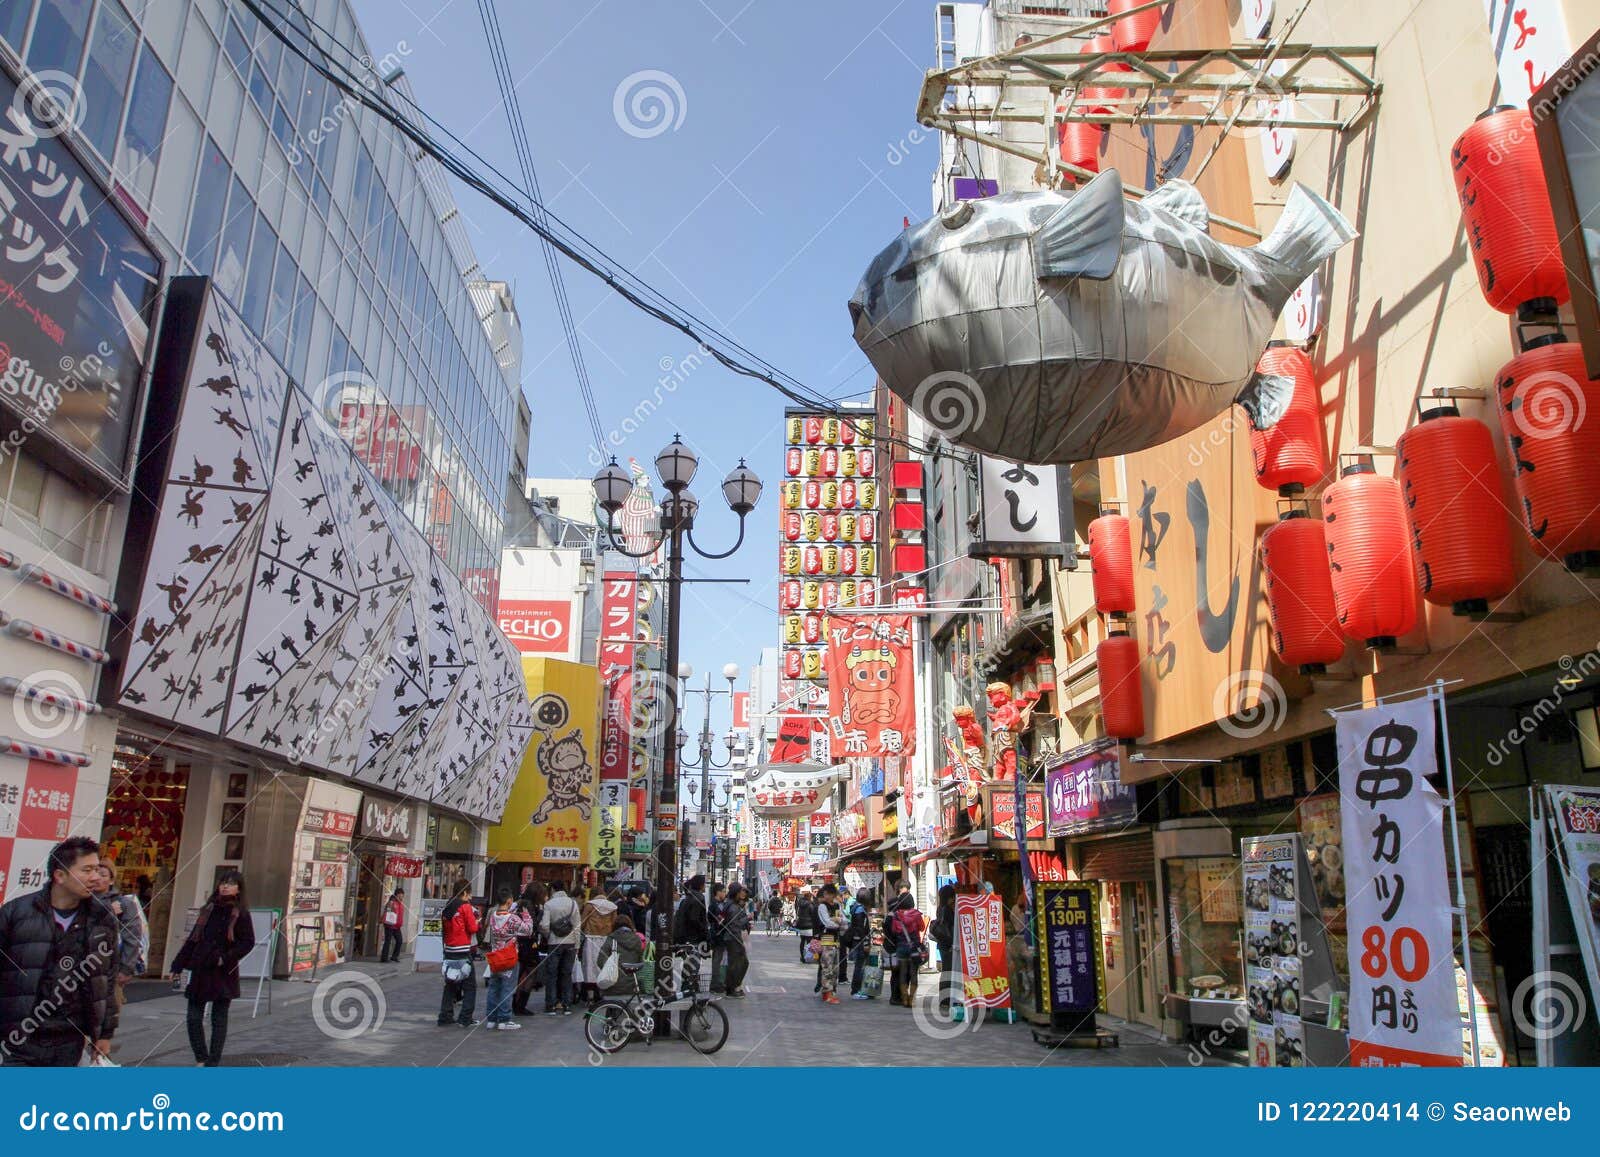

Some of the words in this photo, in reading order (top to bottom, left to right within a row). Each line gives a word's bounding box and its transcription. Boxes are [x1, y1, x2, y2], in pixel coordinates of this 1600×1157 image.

[500, 618, 563, 639] ECHO
[604, 577, 632, 684] カラオケ
[789, 618, 799, 638] ロース
[606, 701, 619, 723] BIG
[604, 725, 619, 768] ECHO
[844, 728, 903, 753] 赤鬼
[25, 787, 70, 812] たこ焼き
[1356, 718, 1418, 921] 串カツ
[561, 849, 579, 858] 47年
[18, 868, 47, 888] 串カ
[1053, 895, 1080, 909] 全皿
[990, 904, 999, 936] はまち
[1050, 910, 1087, 926] 130円
[961, 916, 978, 975] トロサーモン
[1361, 925, 1430, 983] 80
[1400, 988, 1418, 1034] より
